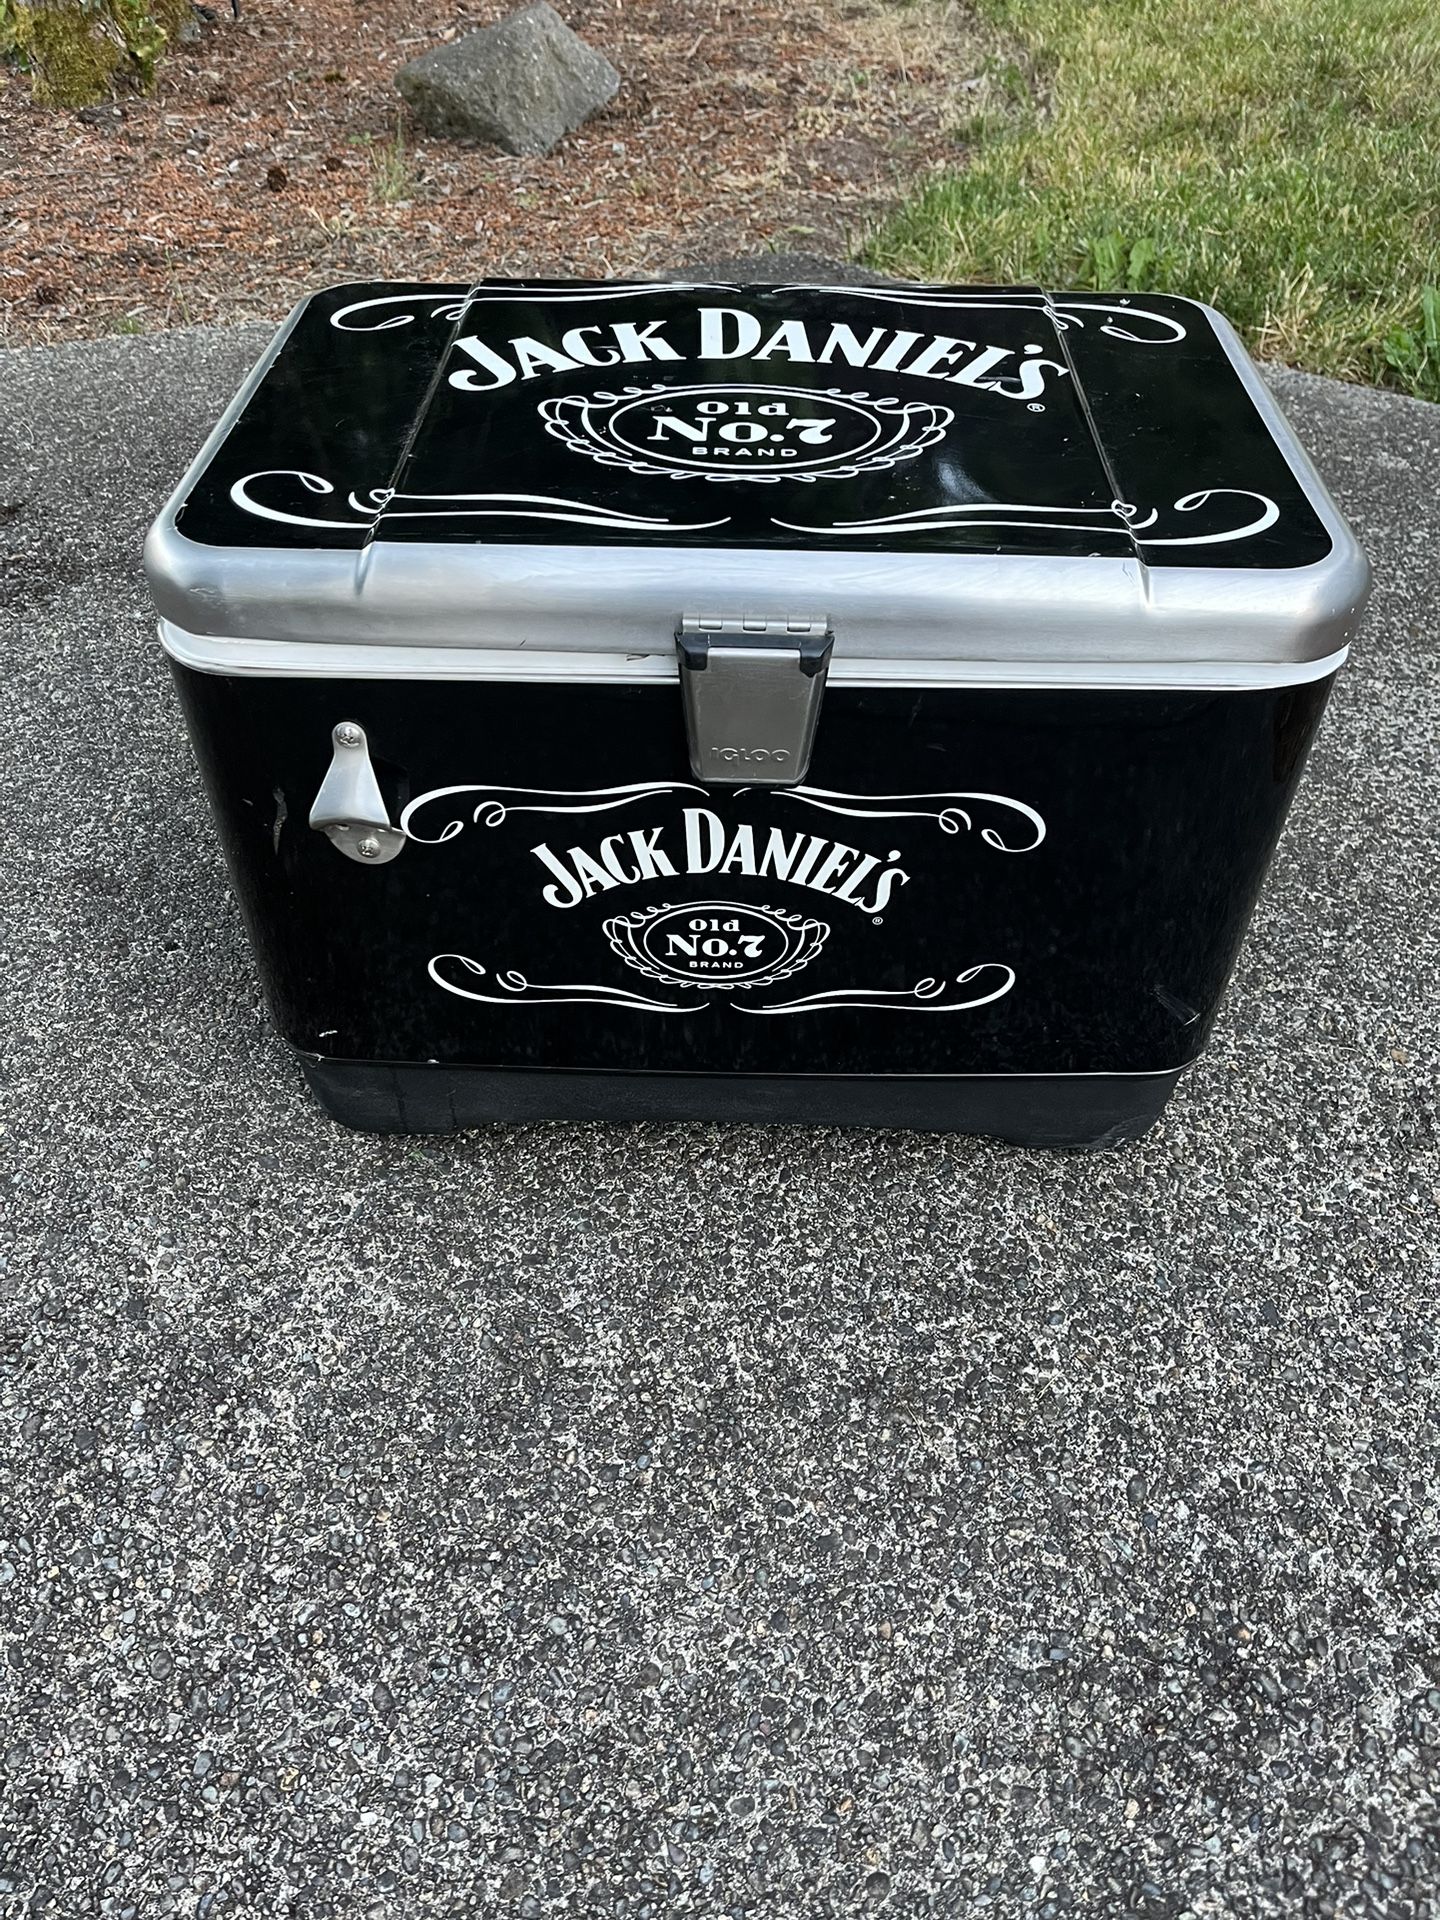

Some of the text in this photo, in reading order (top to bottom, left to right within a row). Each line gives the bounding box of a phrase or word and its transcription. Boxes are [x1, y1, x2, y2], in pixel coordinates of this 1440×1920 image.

[447, 307, 1069, 401] JACK DANIEL'S
[695, 401, 790, 417] Old
[646, 416, 833, 444] No.7
[692, 446, 798, 458] BRAND
[529, 807, 911, 914] JACK DANIEL'S
[687, 918, 741, 933] Old
[664, 933, 766, 959] No.7
[688, 960, 744, 970] BRAND
